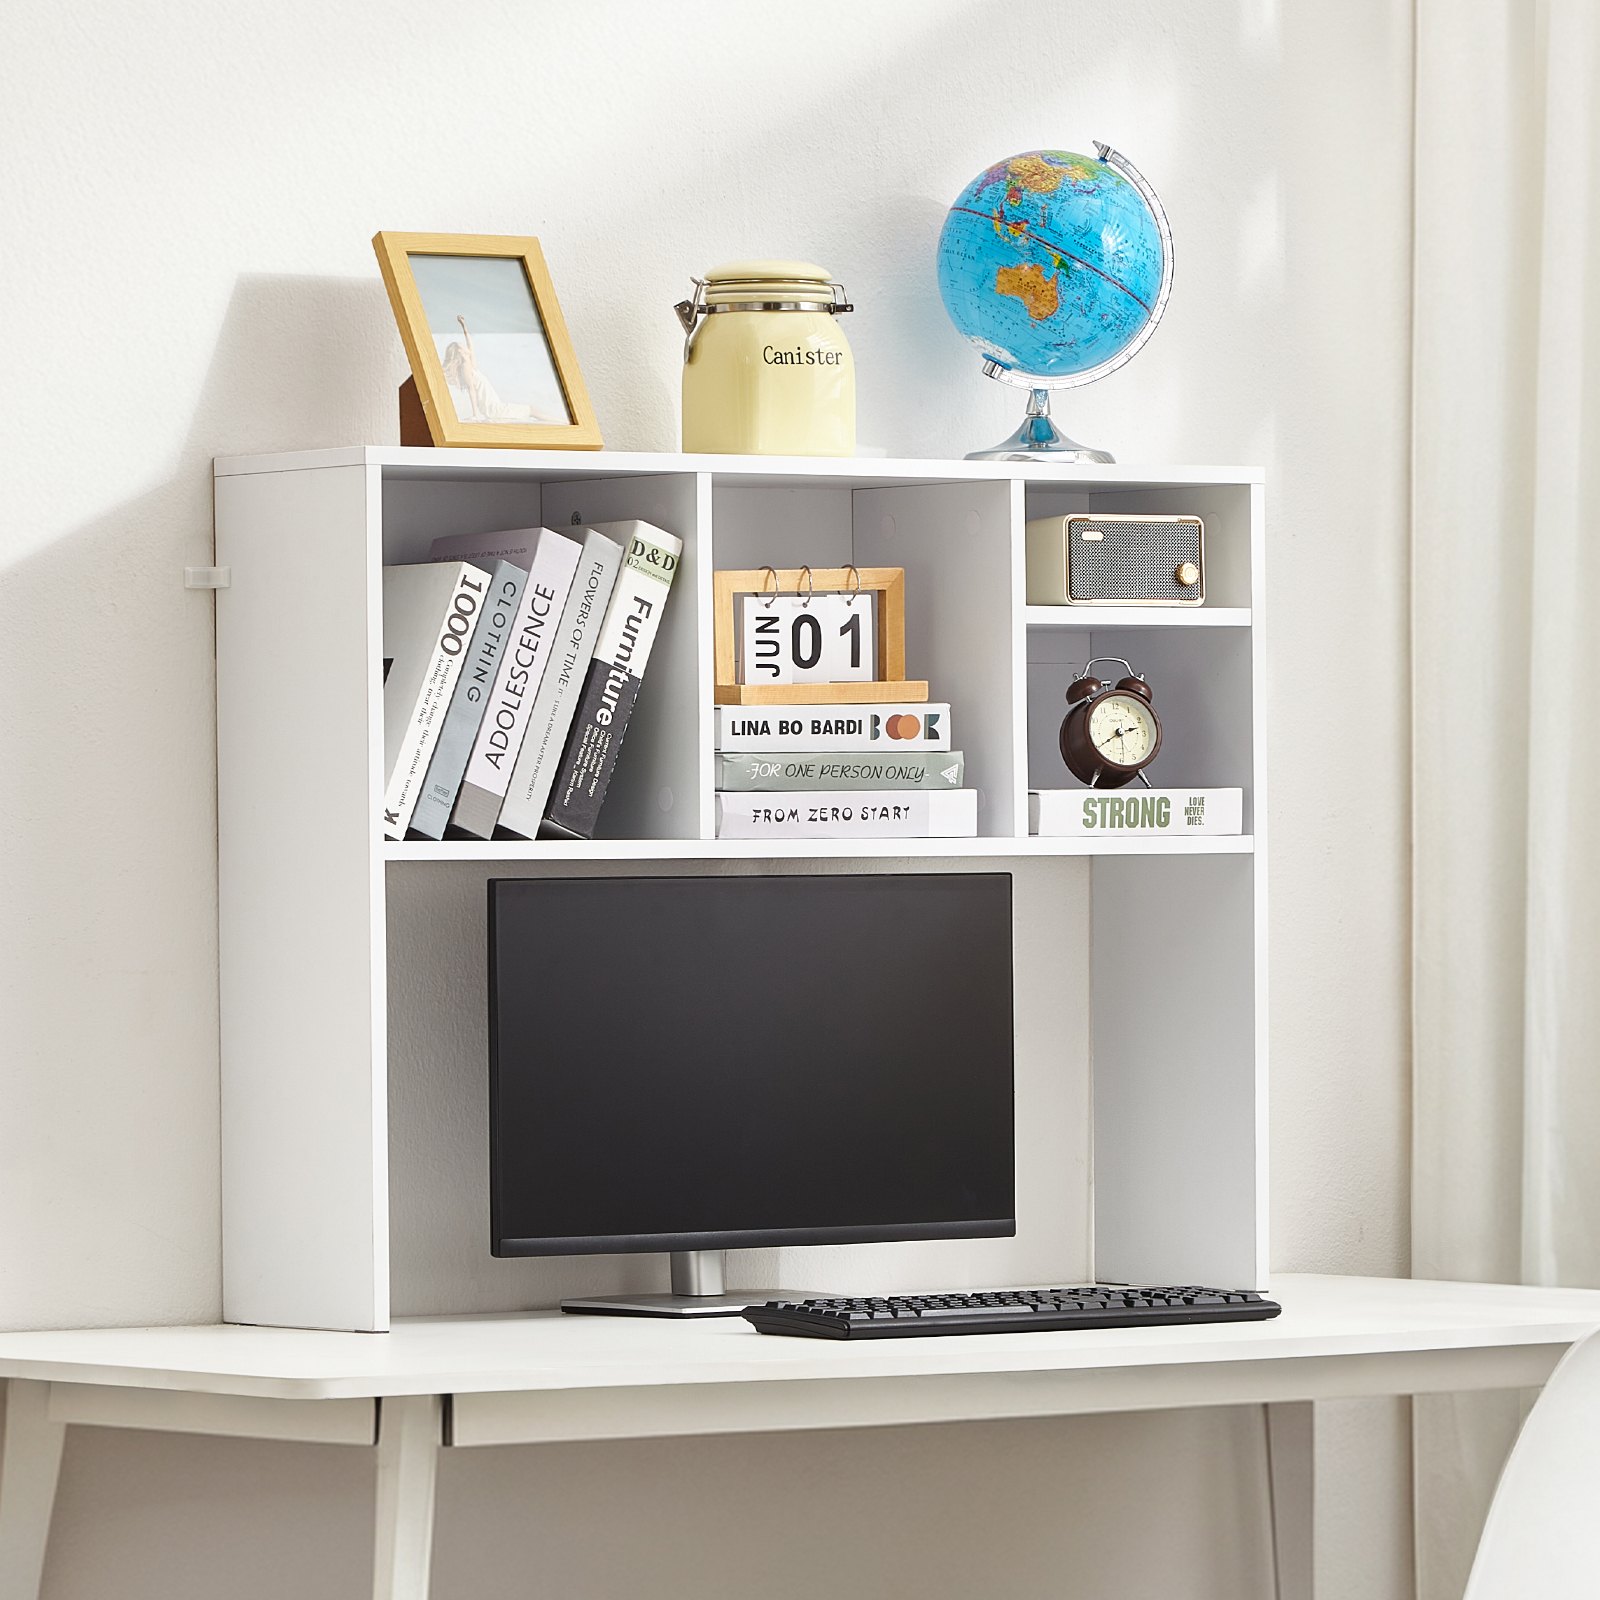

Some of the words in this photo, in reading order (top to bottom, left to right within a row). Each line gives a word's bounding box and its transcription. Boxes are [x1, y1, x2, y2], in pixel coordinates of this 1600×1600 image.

[763, 345, 843, 365] Canister
[627, 556, 640, 569] 02
[576, 561, 604, 628] FLOWERS
[440, 574, 482, 656] 1000
[467, 581, 517, 703] CLOTHING
[569, 628, 583, 650] OF
[755, 616, 781, 677] JUN
[558, 651, 577, 688] TIME
[596, 595, 653, 726] Furniture
[434, 659, 453, 698] Completely
[485, 583, 555, 771] ADOLESCENCE
[426, 701, 438, 727] change
[419, 729, 429, 747] their
[543, 722, 553, 746] DREAM
[583, 723, 593, 745] Special
[590, 726, 600, 743] Office
[731, 720, 771, 736] LINA
[778, 720, 803, 736] BO
[811, 719, 863, 735] BARDI
[576, 743, 587, 765] Feature
[602, 733, 612, 754] Current
[409, 748, 421, 777] attitude
[536, 745, 546, 765] AFTER
[583, 743, 594, 768] Furniture
[589, 748, 600, 773] Furniture
[595, 753, 606, 778] Furniture
[576, 767, 587, 789] System
[784, 763, 815, 778] ONE
[819, 764, 883, 779] PERSON
[398, 779, 411, 807] towards
[526, 765, 539, 801] PROSPERITY
[588, 777, 599, 798] Design
[1184, 806, 1205, 816] NEVER
[1188, 796, 1205, 806] LOVE
[384, 807, 400, 826] K
[752, 807, 800, 823] FROM
[807, 807, 853, 822] ZERO
[860, 805, 910, 820] START
[1083, 797, 1171, 829] STRONG
[1187, 816, 1205, 826] DIES.
